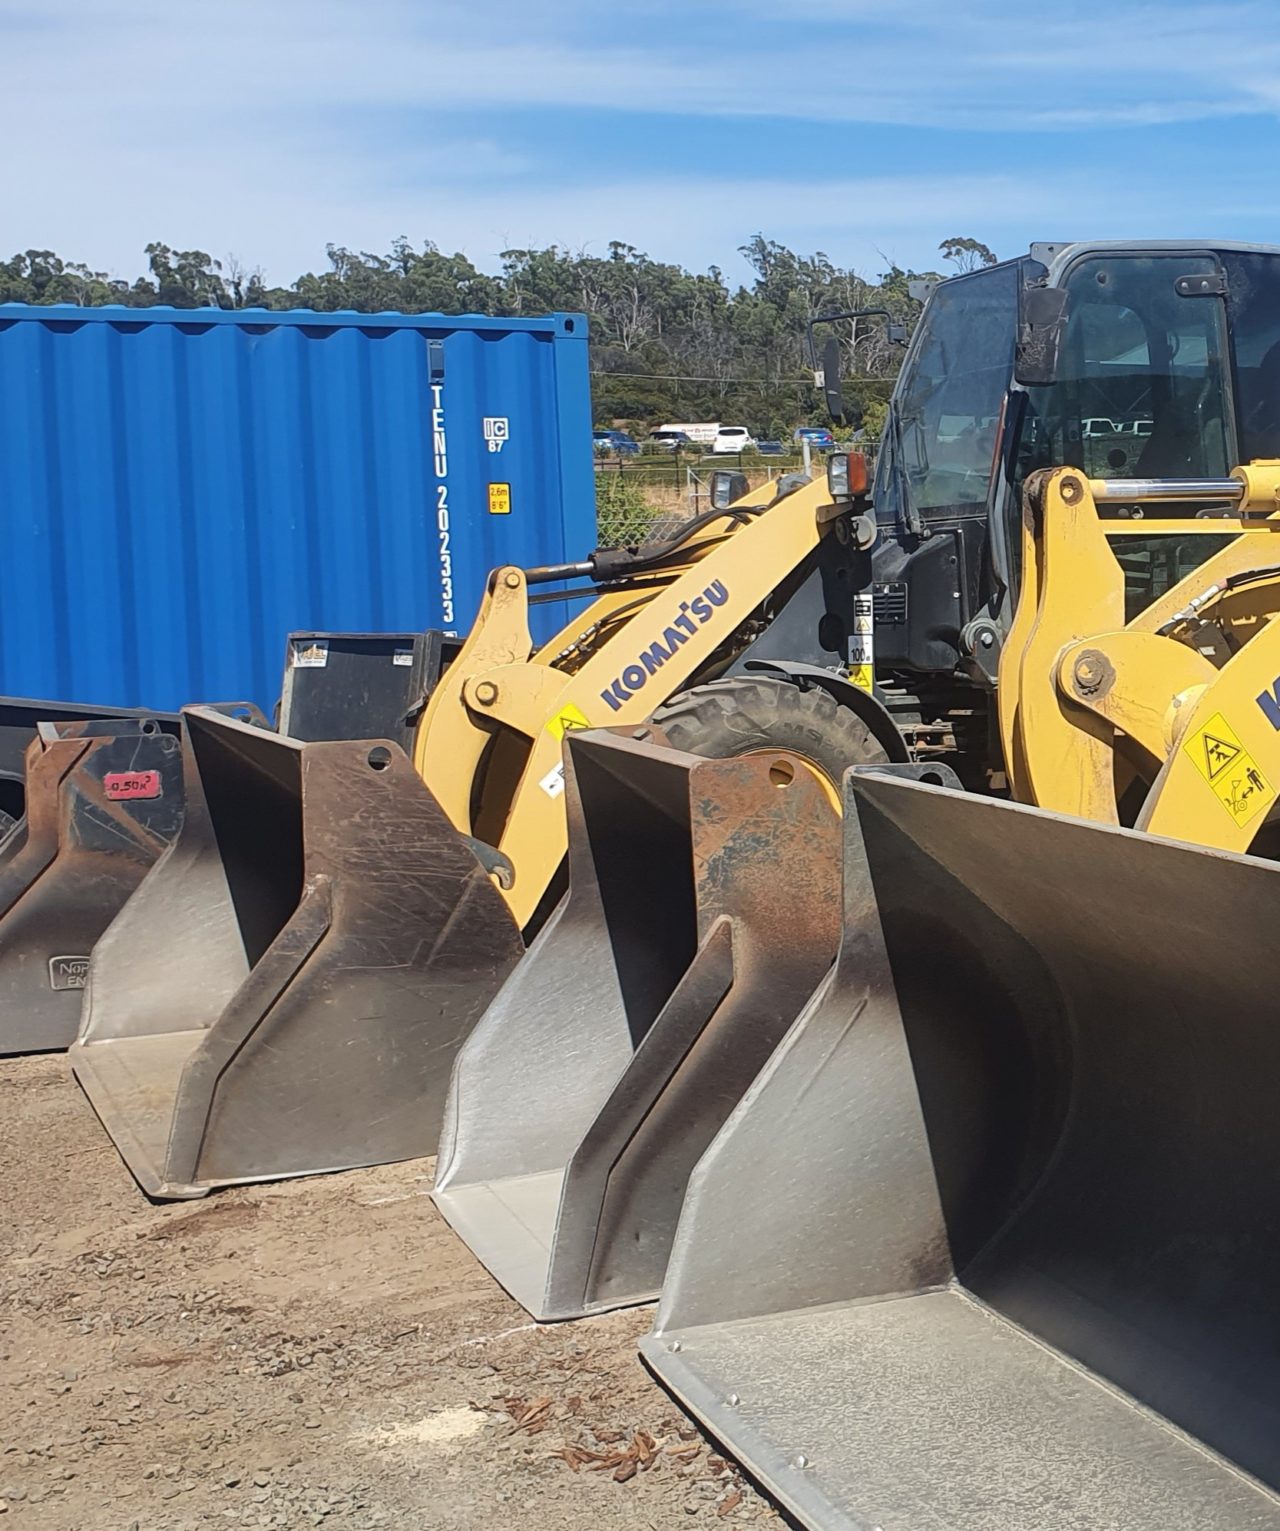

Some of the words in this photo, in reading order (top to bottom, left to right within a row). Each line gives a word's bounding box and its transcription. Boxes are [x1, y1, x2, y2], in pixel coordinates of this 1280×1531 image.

[431, 385, 447, 478] TENU
[488, 440, 504, 453] 87
[437, 485, 454, 623] 202333
[600, 578, 730, 712] KOMATSU
[850, 647, 866, 662] 100
